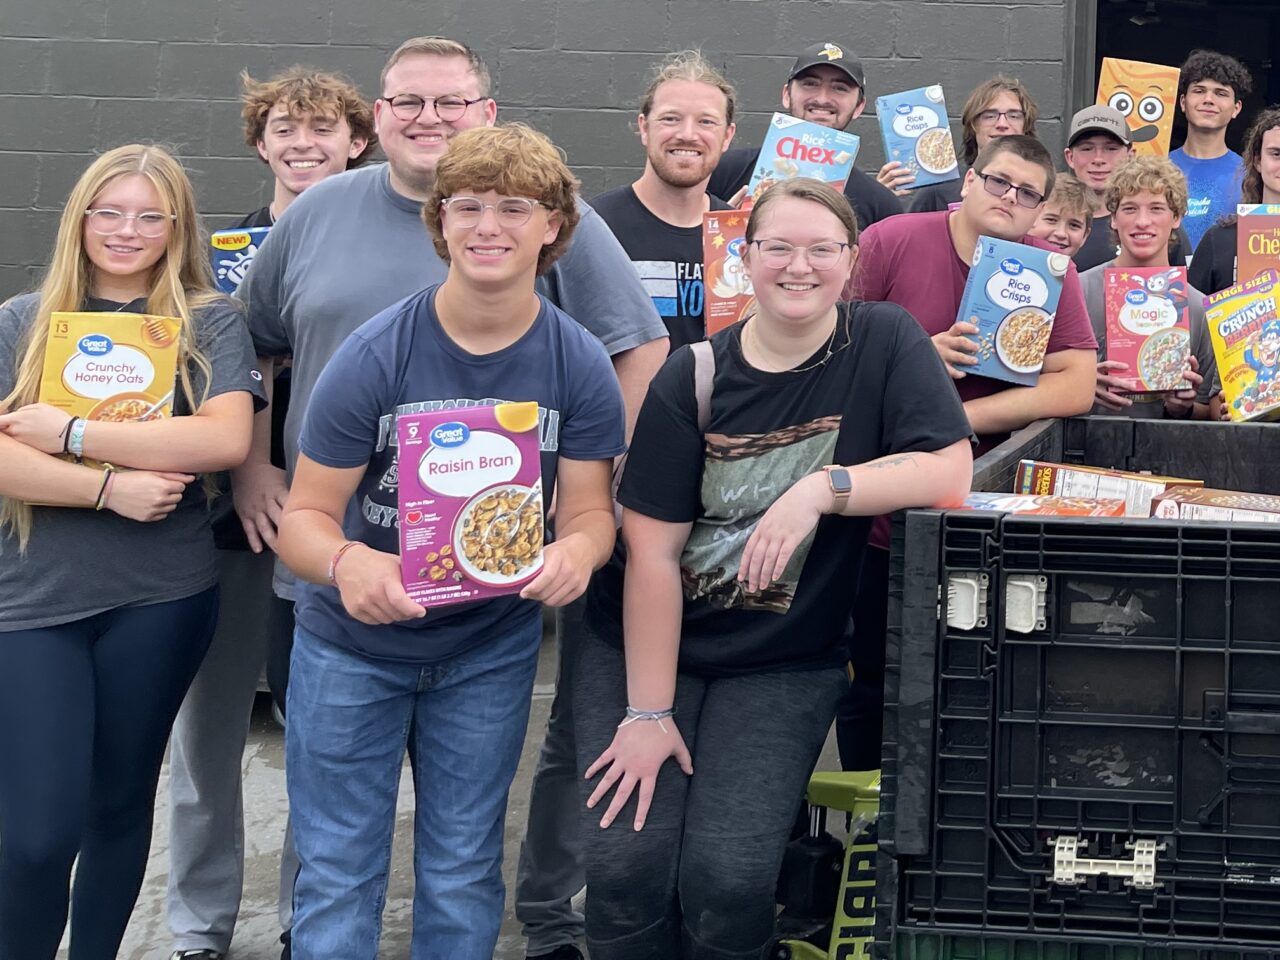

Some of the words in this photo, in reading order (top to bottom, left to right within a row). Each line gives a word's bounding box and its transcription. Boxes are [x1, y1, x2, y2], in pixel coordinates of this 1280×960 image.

[801, 133, 826, 146] Rice
[775, 136, 837, 166] Chex
[707, 220, 720, 229] 14
[216, 236, 247, 246] NEW!
[988, 246, 995, 255] 8
[1007, 278, 1031, 292] Rice
[1208, 285, 1244, 305] LARGE
[1245, 272, 1272, 290] SIZE!
[1000, 288, 1032, 304] Crisps
[1130, 308, 1169, 321] Magic
[1218, 297, 1277, 338] CRUNCH
[54, 323, 70, 334] 13
[82, 338, 107, 348] Great
[85, 361, 137, 375] Crunchy
[74, 372, 114, 385] Honey
[116, 373, 145, 385] Oats
[408, 426, 418, 438] 9
[434, 427, 464, 439] Great
[428, 458, 474, 476] Raisin
[479, 455, 514, 470] Bran
